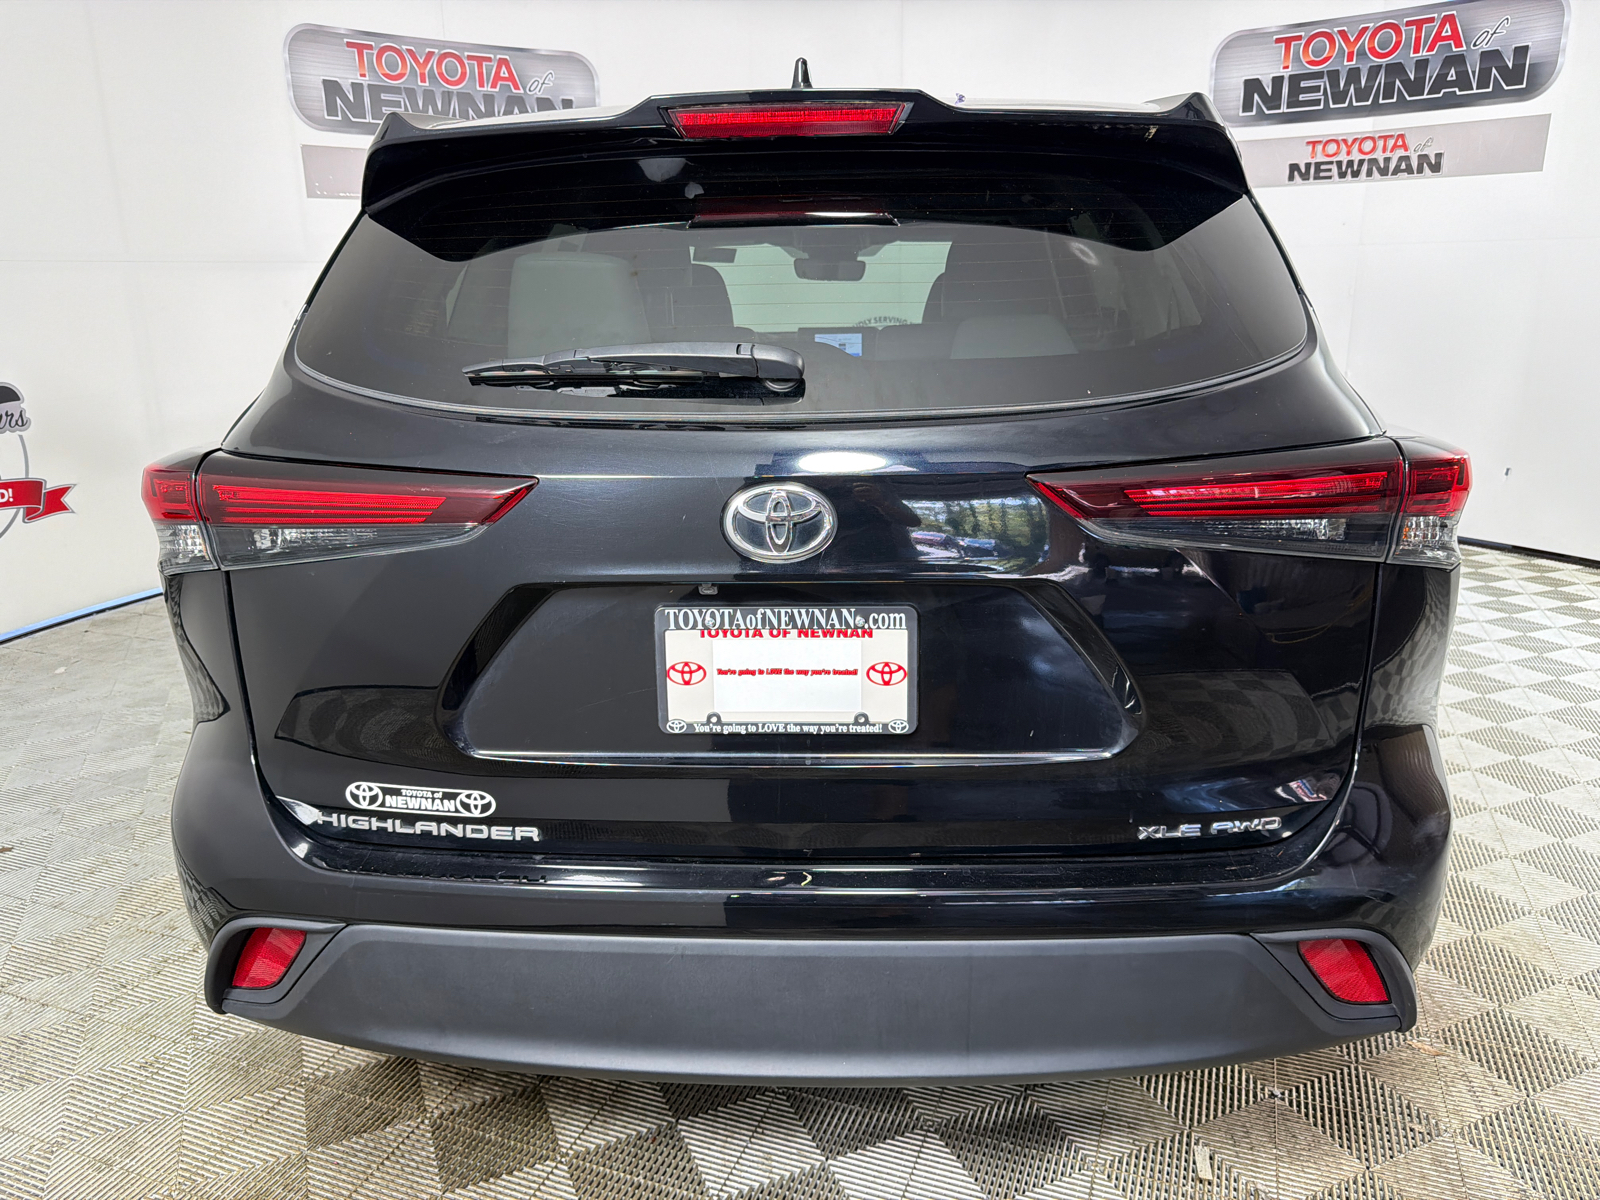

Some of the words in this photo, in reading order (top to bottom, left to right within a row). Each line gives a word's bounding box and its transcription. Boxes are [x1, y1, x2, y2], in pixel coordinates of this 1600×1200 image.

[1274, 12, 1465, 70] TOYOTA
[1472, 17, 1510, 49] of
[345, 40, 522, 93] TOYOTA
[527, 71, 555, 94] of
[1241, 44, 1530, 115] NEWNAN
[1306, 134, 1409, 159] TOYOTA
[1413, 137, 1433, 153] of
[1288, 152, 1443, 182] NEWNAN
[700, 629, 763, 638] TOYOTA
[769, 629, 791, 638] OF
[797, 629, 873, 638] NEWNAN
[693, 723, 721, 733] You're
[723, 724, 746, 735] going
[748, 724, 757, 733] to
[758, 723, 785, 733] LOVE
[787, 723, 800, 733] the
[802, 726, 818, 735] way
[820, 723, 847, 735] you're
[850, 723, 882, 733] treated!
[385, 795, 455, 811] NEWNAN
[401, 789, 433, 798] TOYOTA
[316, 811, 540, 842] HIGHLANDER
[1137, 824, 1201, 840] XLE
[1210, 816, 1282, 835] AWD
